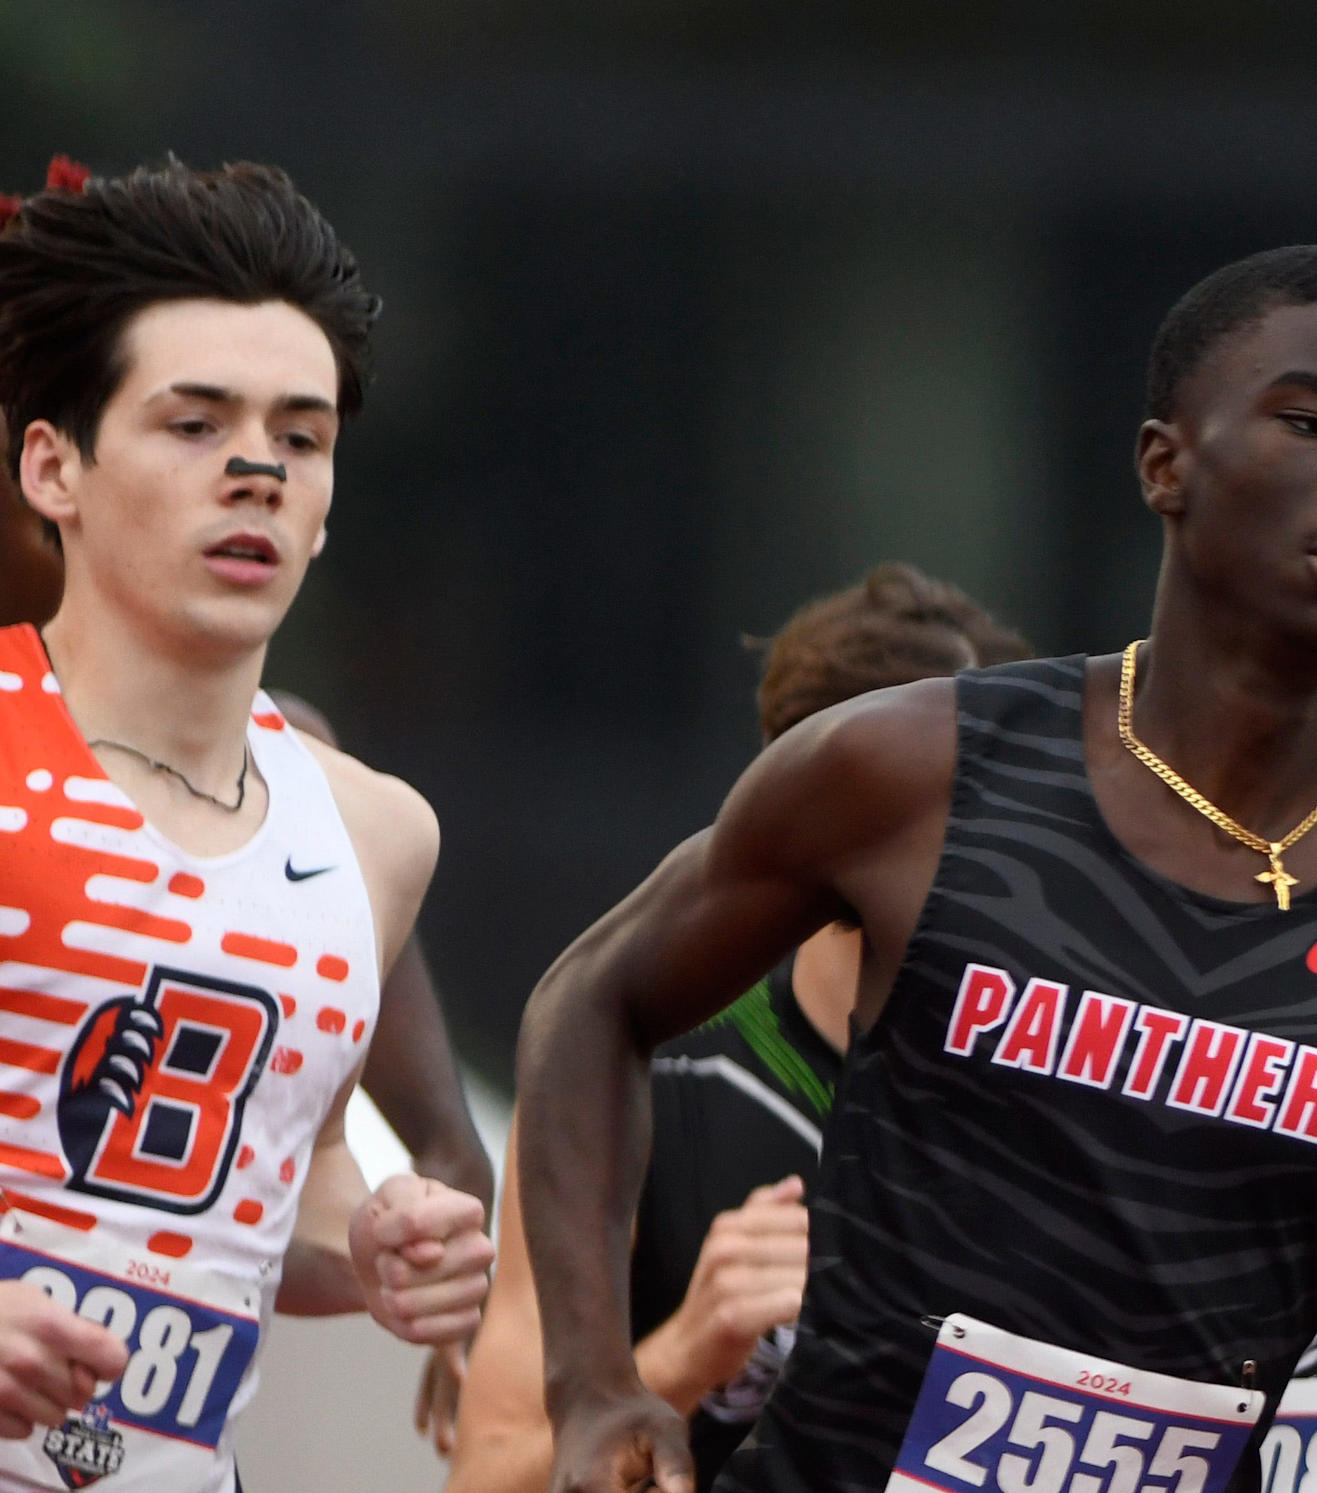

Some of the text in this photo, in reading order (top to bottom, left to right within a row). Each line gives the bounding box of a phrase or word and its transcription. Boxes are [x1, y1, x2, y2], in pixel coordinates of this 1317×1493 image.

[66, 964, 281, 1216] B
[126, 1259, 171, 1286] 2024
[1076, 1370, 1132, 1397] 2024
[46, 1429, 125, 1474] STATE
